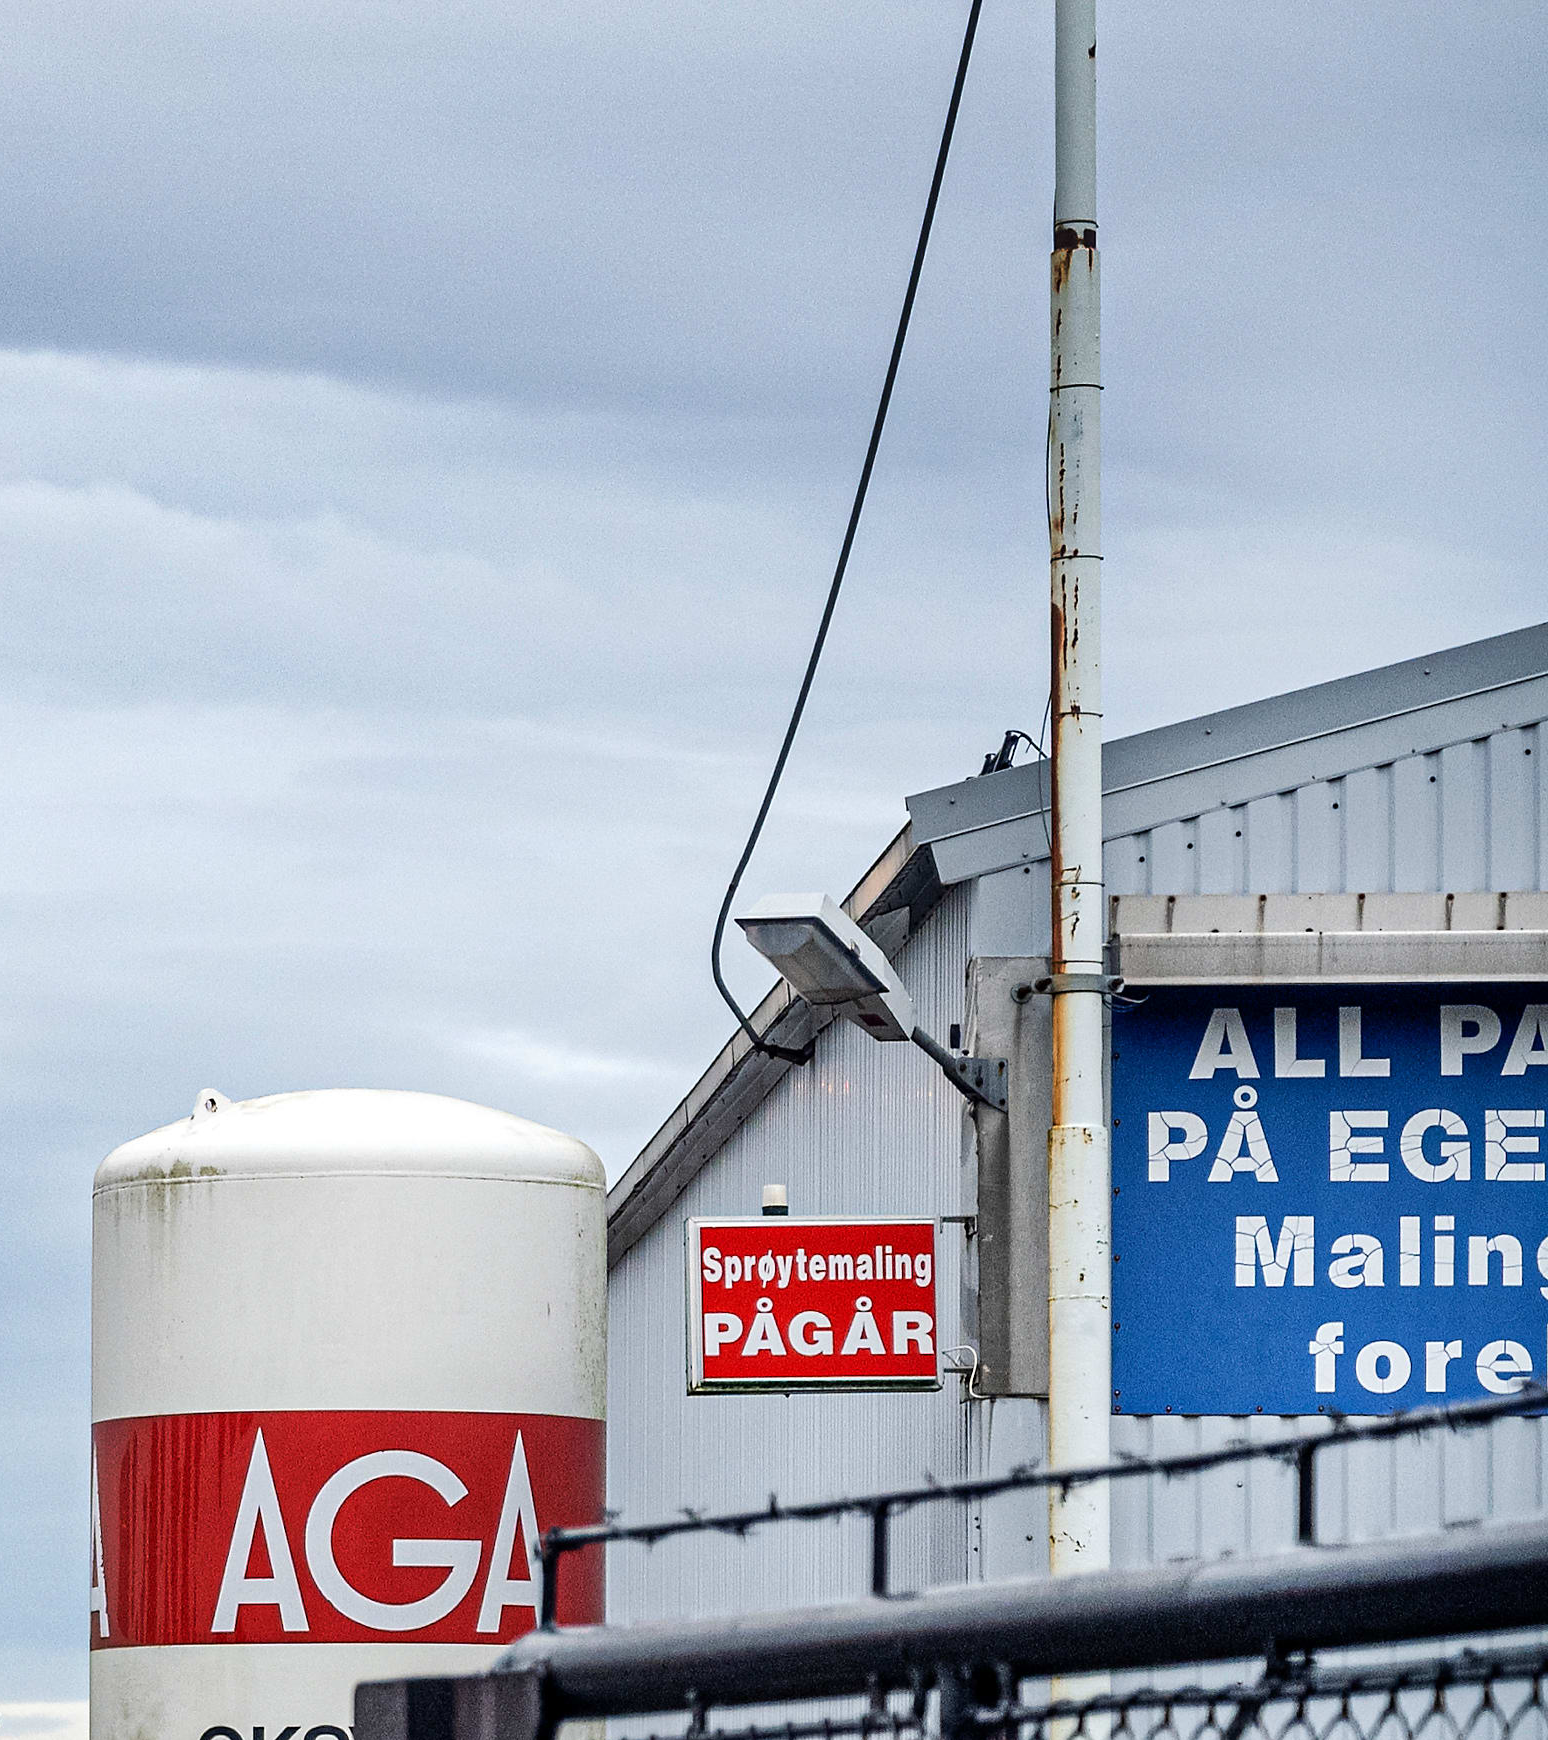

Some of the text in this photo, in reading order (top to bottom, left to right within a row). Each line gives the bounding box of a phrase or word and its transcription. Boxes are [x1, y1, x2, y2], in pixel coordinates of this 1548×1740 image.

[1190, 1006, 1392, 1080] ALL
[1148, 1086, 1547, 1184] PÅ EGE
[703, 1245, 933, 1290] Sprøytemaling
[1235, 1215, 1548, 1301] Malin
[704, 1297, 935, 1357] PÅGÅR
[1309, 1321, 1548, 1395] fore
[211, 1426, 544, 1633] AGA
